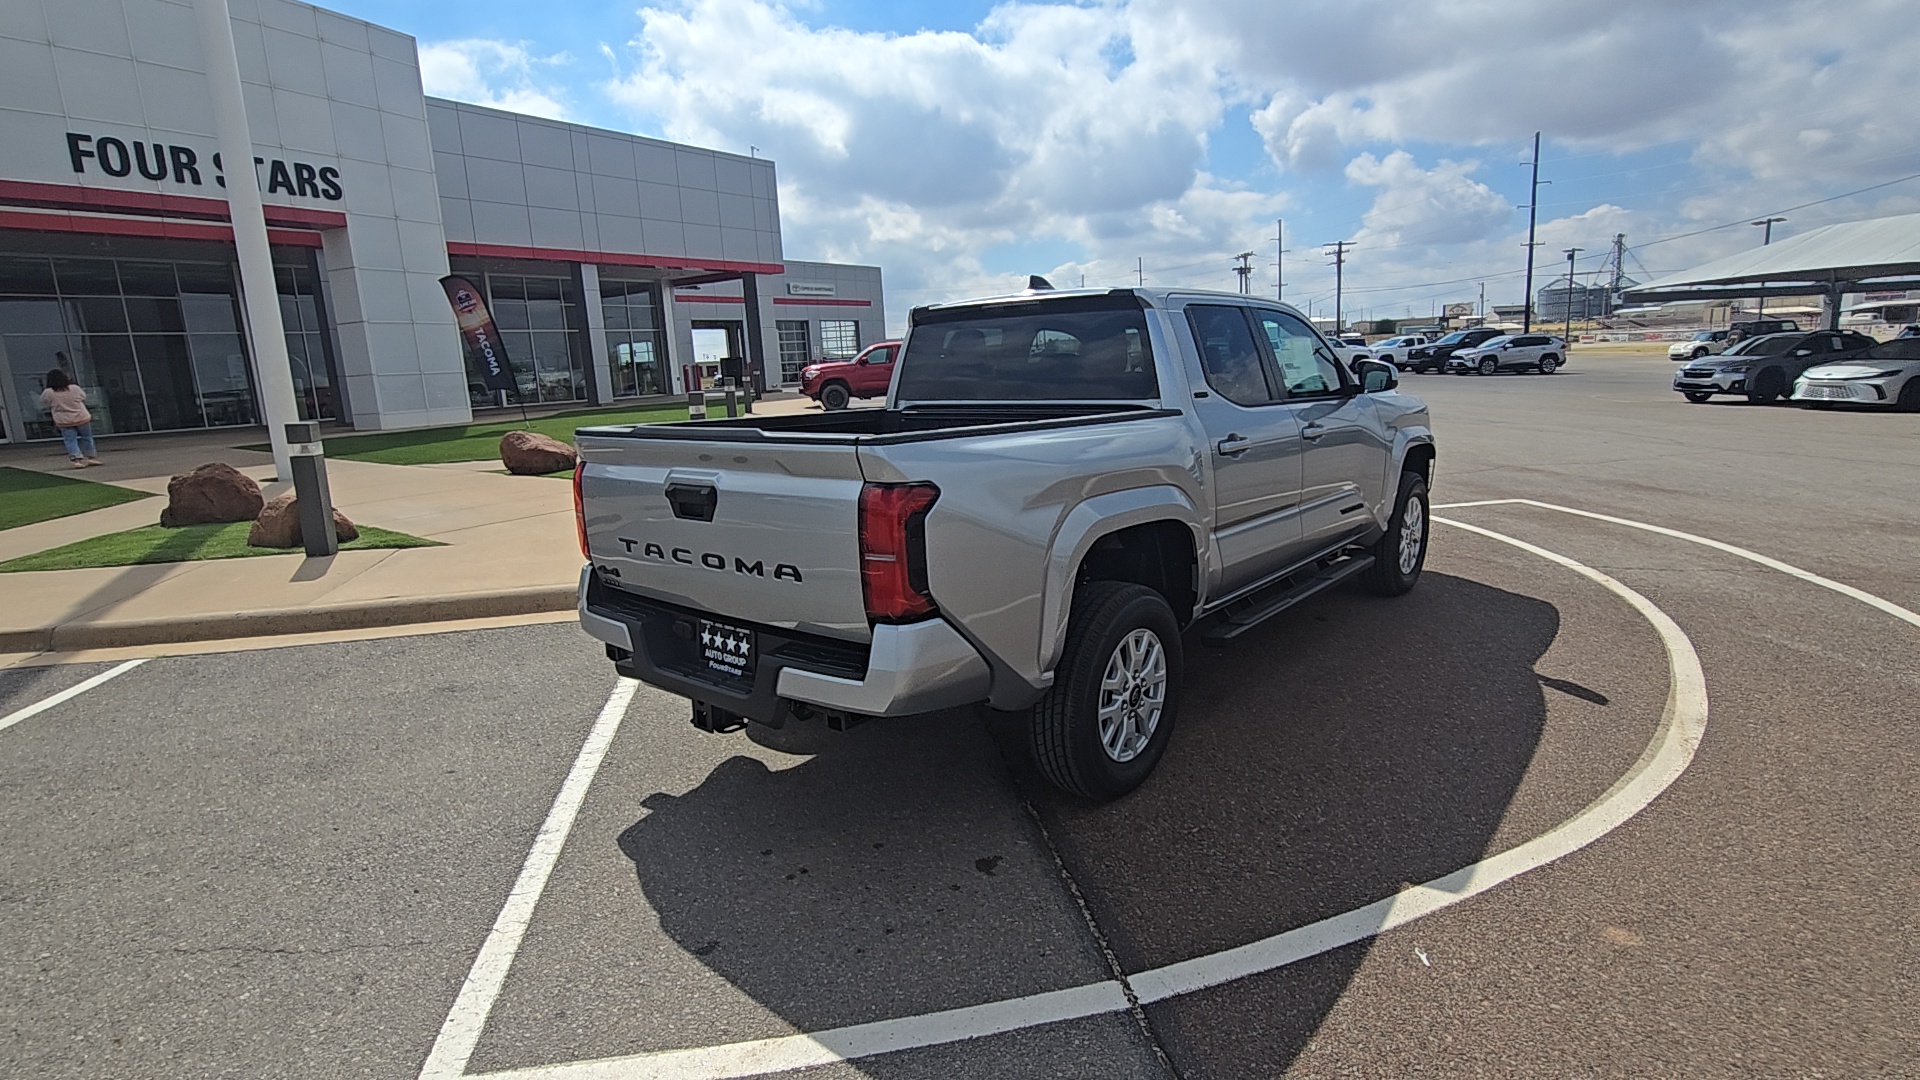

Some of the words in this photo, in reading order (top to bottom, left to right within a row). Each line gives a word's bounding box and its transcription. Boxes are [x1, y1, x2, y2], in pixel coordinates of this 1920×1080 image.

[66, 132, 202, 186] FOUR
[475, 326, 501, 376] TACOMA
[617, 537, 804, 583] TACOMA
[704, 648, 723, 661] AUTO
[722, 653, 747, 667] GROUP
